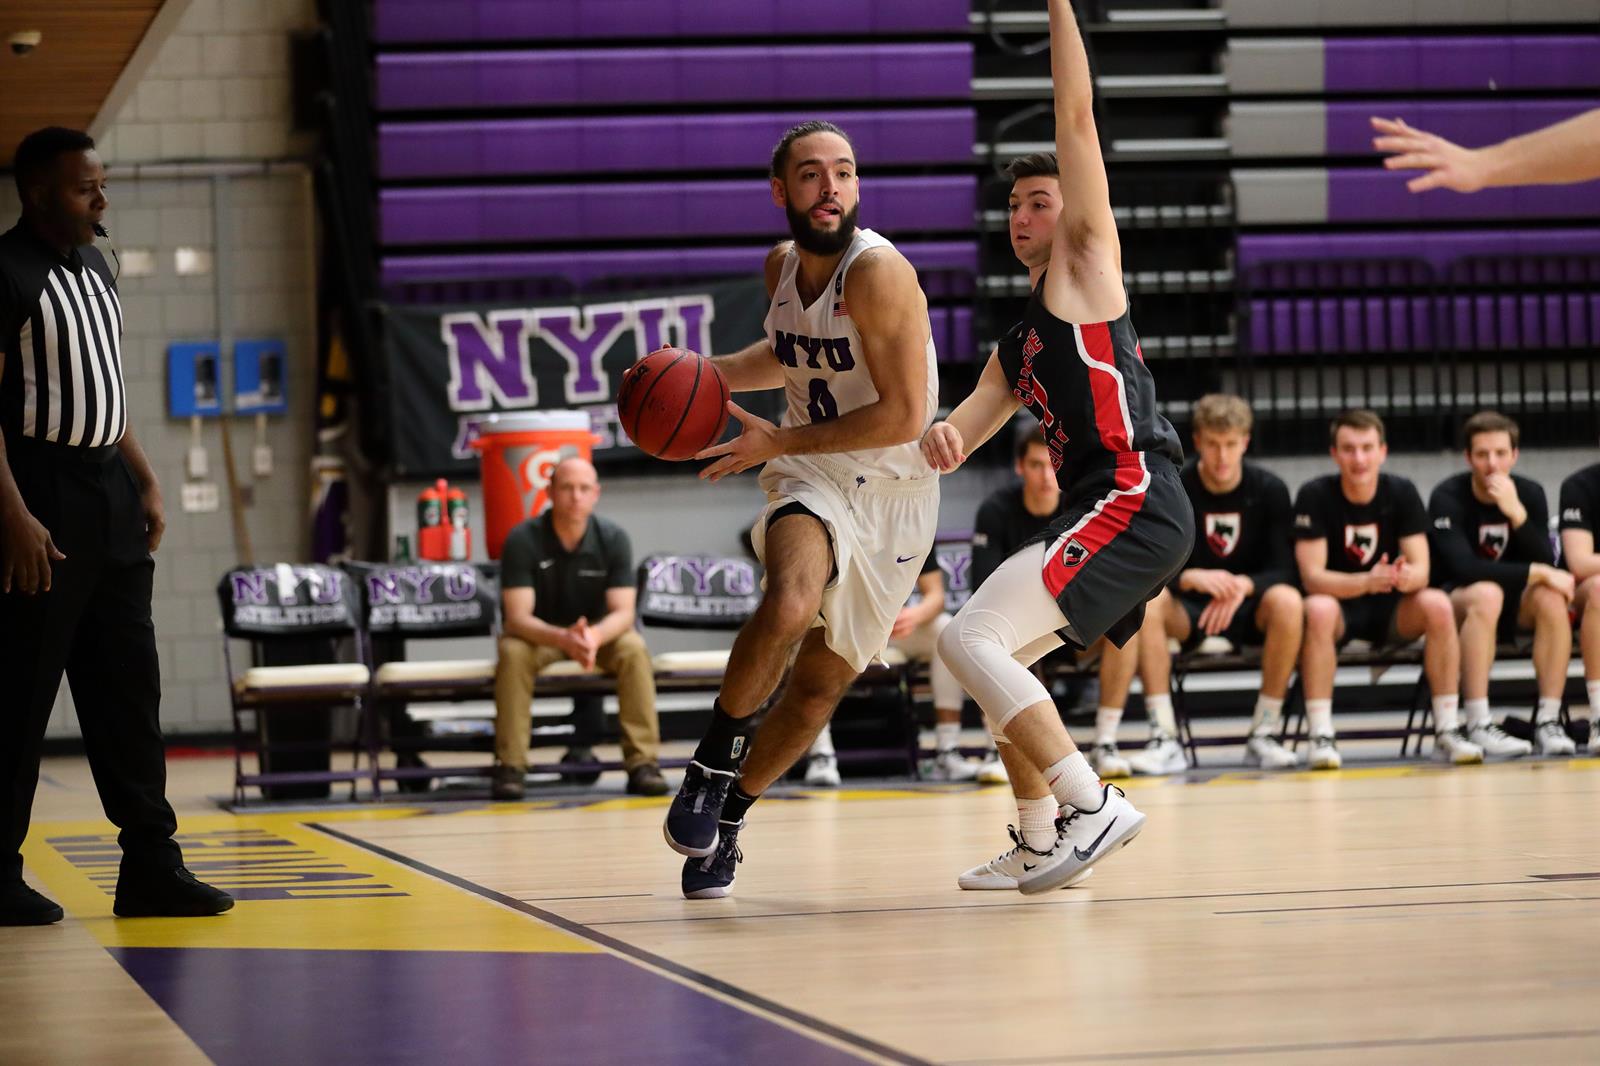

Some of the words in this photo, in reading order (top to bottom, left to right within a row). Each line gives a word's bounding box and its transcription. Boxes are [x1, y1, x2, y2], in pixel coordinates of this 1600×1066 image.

[441, 294, 715, 412] NYU
[775, 330, 856, 373] NYU
[231, 565, 342, 605] NYU
[366, 566, 477, 604] NYU
[646, 557, 755, 595] NYU
